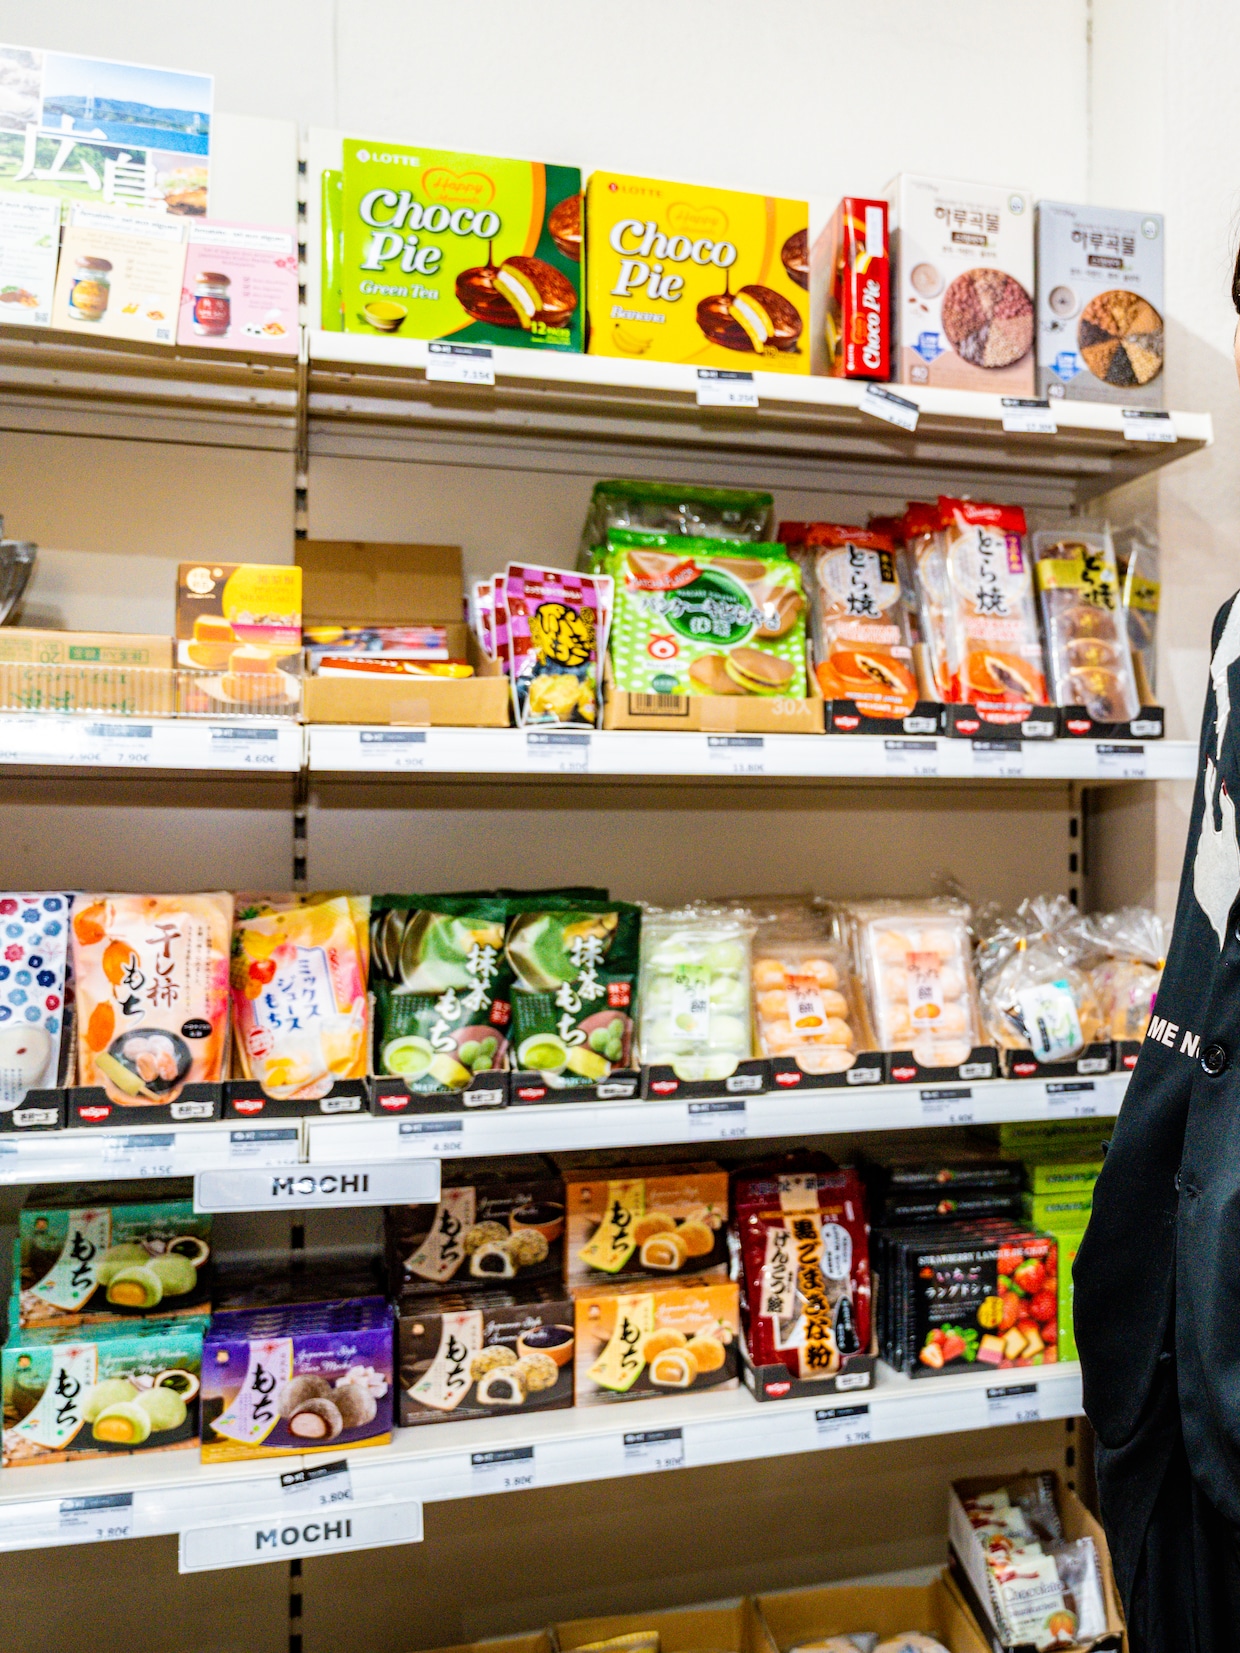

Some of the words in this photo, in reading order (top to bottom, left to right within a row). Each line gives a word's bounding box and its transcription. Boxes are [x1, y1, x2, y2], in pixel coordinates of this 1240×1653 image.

[372, 151, 420, 167] LOTTE
[359, 188, 501, 239] Choco
[622, 186, 663, 198] LOTTE
[610, 219, 737, 268] Choco
[934, 206, 1000, 235] 하루곡물
[1071, 229, 1136, 257] 하루곡물
[360, 231, 443, 275] Pie
[360, 280, 408, 297] Green
[411, 284, 440, 300] Tea
[610, 259, 684, 302] Pie
[863, 279, 881, 311] Pie
[531, 321, 546, 335] 12
[610, 306, 666, 324] Banana
[863, 315, 881, 369] Choco
[848, 543, 880, 618] どら焼
[976, 529, 1008, 614] どら焼
[244, 754, 277, 764] 4.60€
[115, 954, 146, 1028] もち
[299, 958, 321, 1018] ミックス
[464, 943, 499, 1011] 抹茶
[569, 935, 606, 1001] 抹茶
[265, 991, 283, 1030] もち
[276, 976, 304, 1033] ジュース
[431, 987, 462, 1053] もち
[555, 980, 587, 1046] もち
[139, 1165, 173, 1176] 6.15€
[271, 1173, 370, 1198] MOCHI
[440, 1209, 462, 1262] もち
[610, 1200, 633, 1253] もち
[70, 1231, 96, 1289] もち
[925, 1282, 993, 1300] ラングドシャ
[447, 1335, 468, 1390] もち
[619, 1316, 641, 1371] もち
[54, 1368, 81, 1426] もち
[252, 1363, 277, 1423] もち
[319, 1489, 351, 1504] 3.80€
[503, 1474, 533, 1486] 3.80€
[255, 1519, 353, 1551] MOCHI
